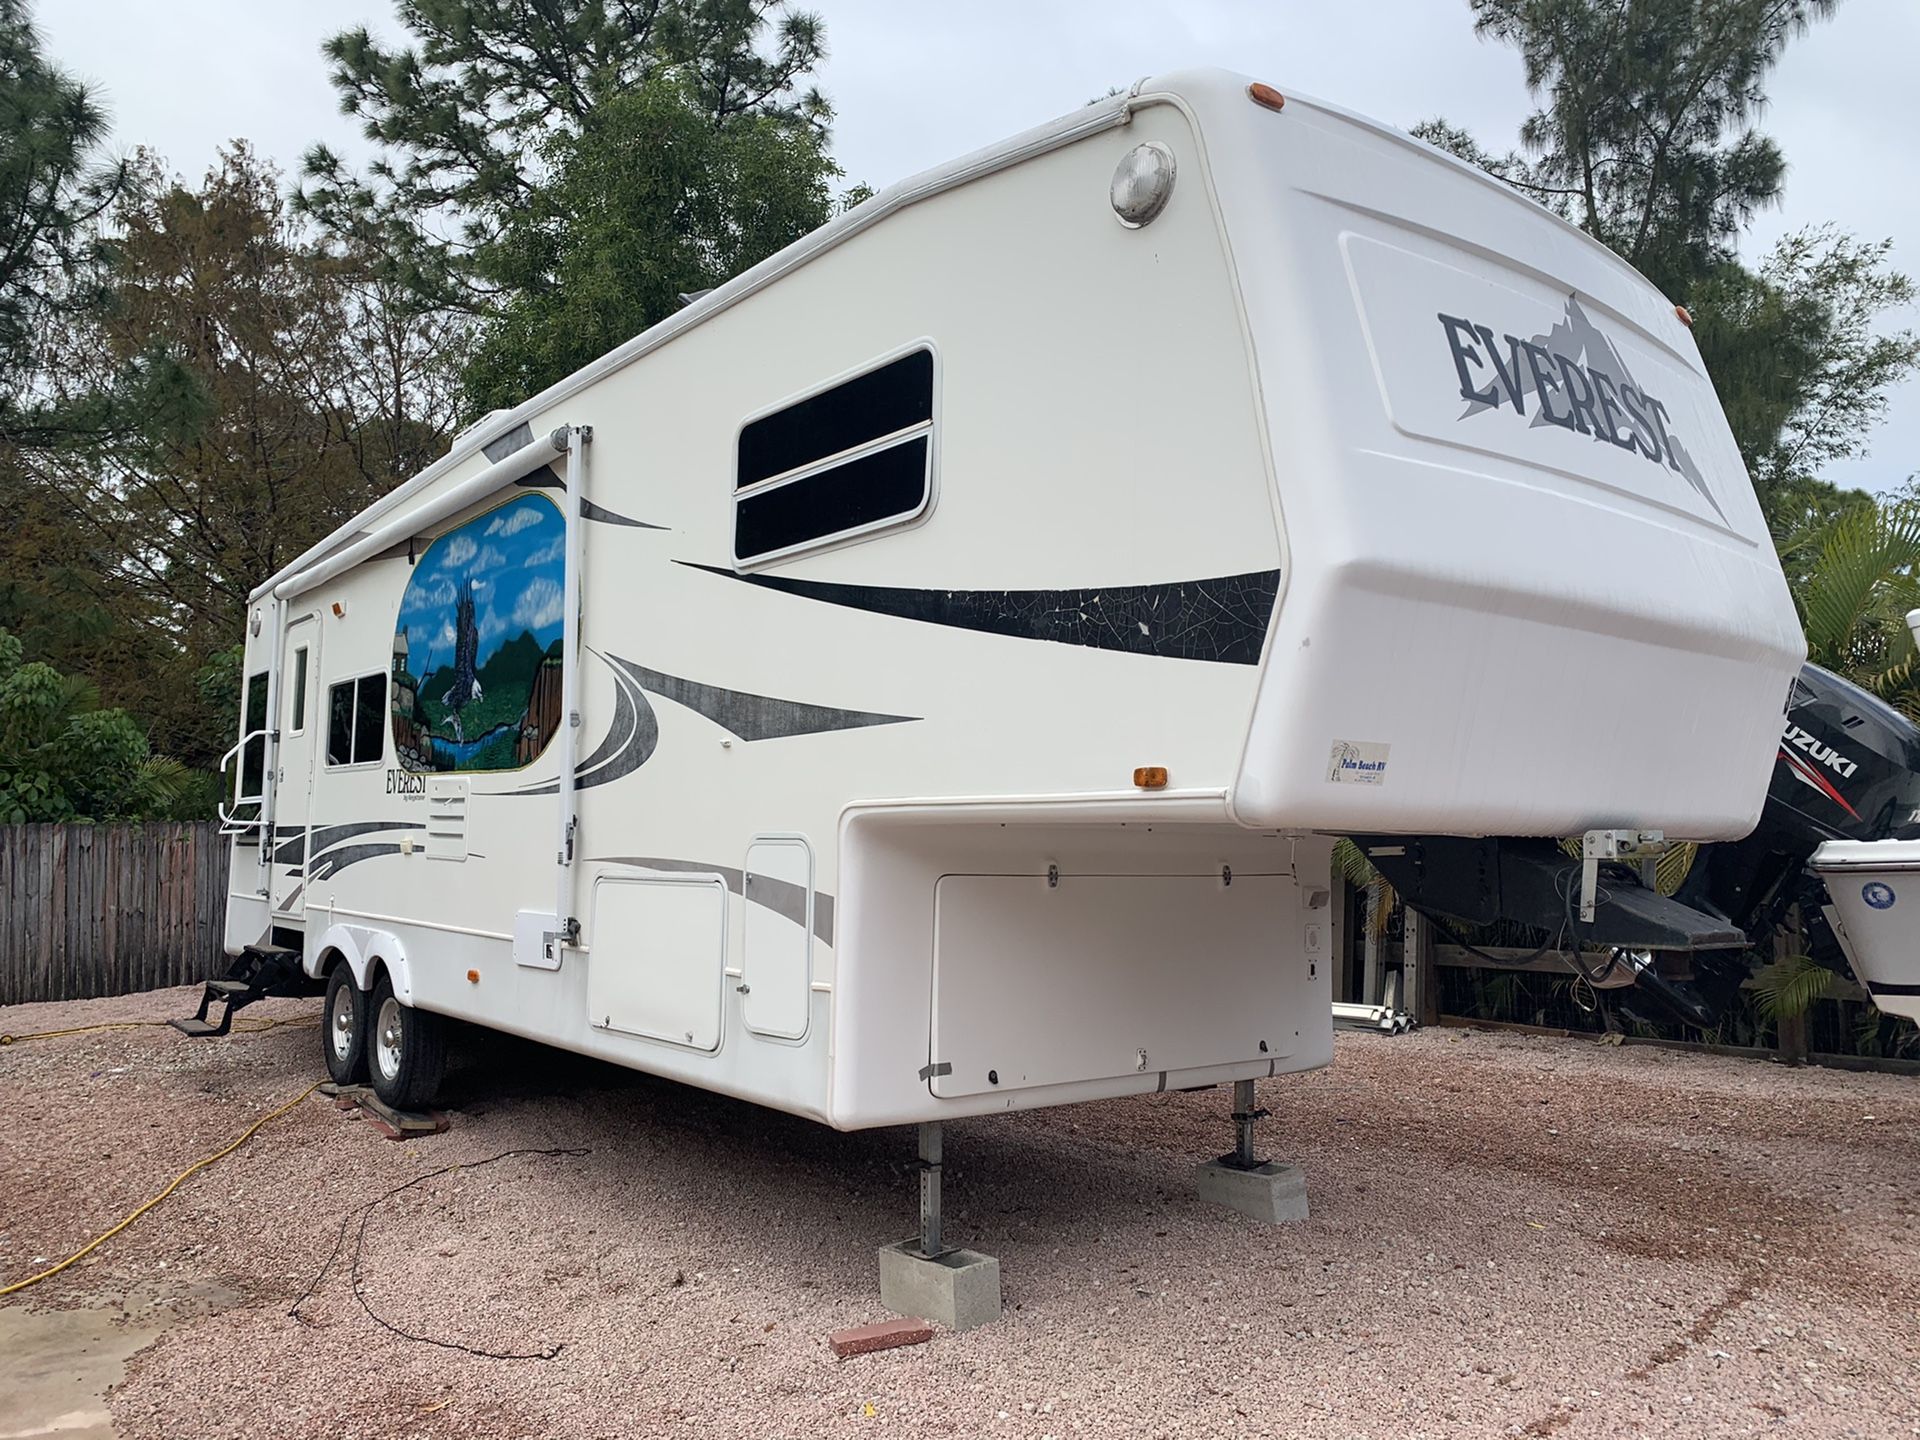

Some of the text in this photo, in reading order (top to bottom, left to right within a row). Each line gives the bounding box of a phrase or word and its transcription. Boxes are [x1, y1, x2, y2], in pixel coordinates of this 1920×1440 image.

[1438, 312, 1681, 472] EVEREST
[1341, 758, 1387, 771] Palm Beach RV
[1782, 719, 1858, 779] UZUKI
[386, 769, 426, 794] EVEREST
